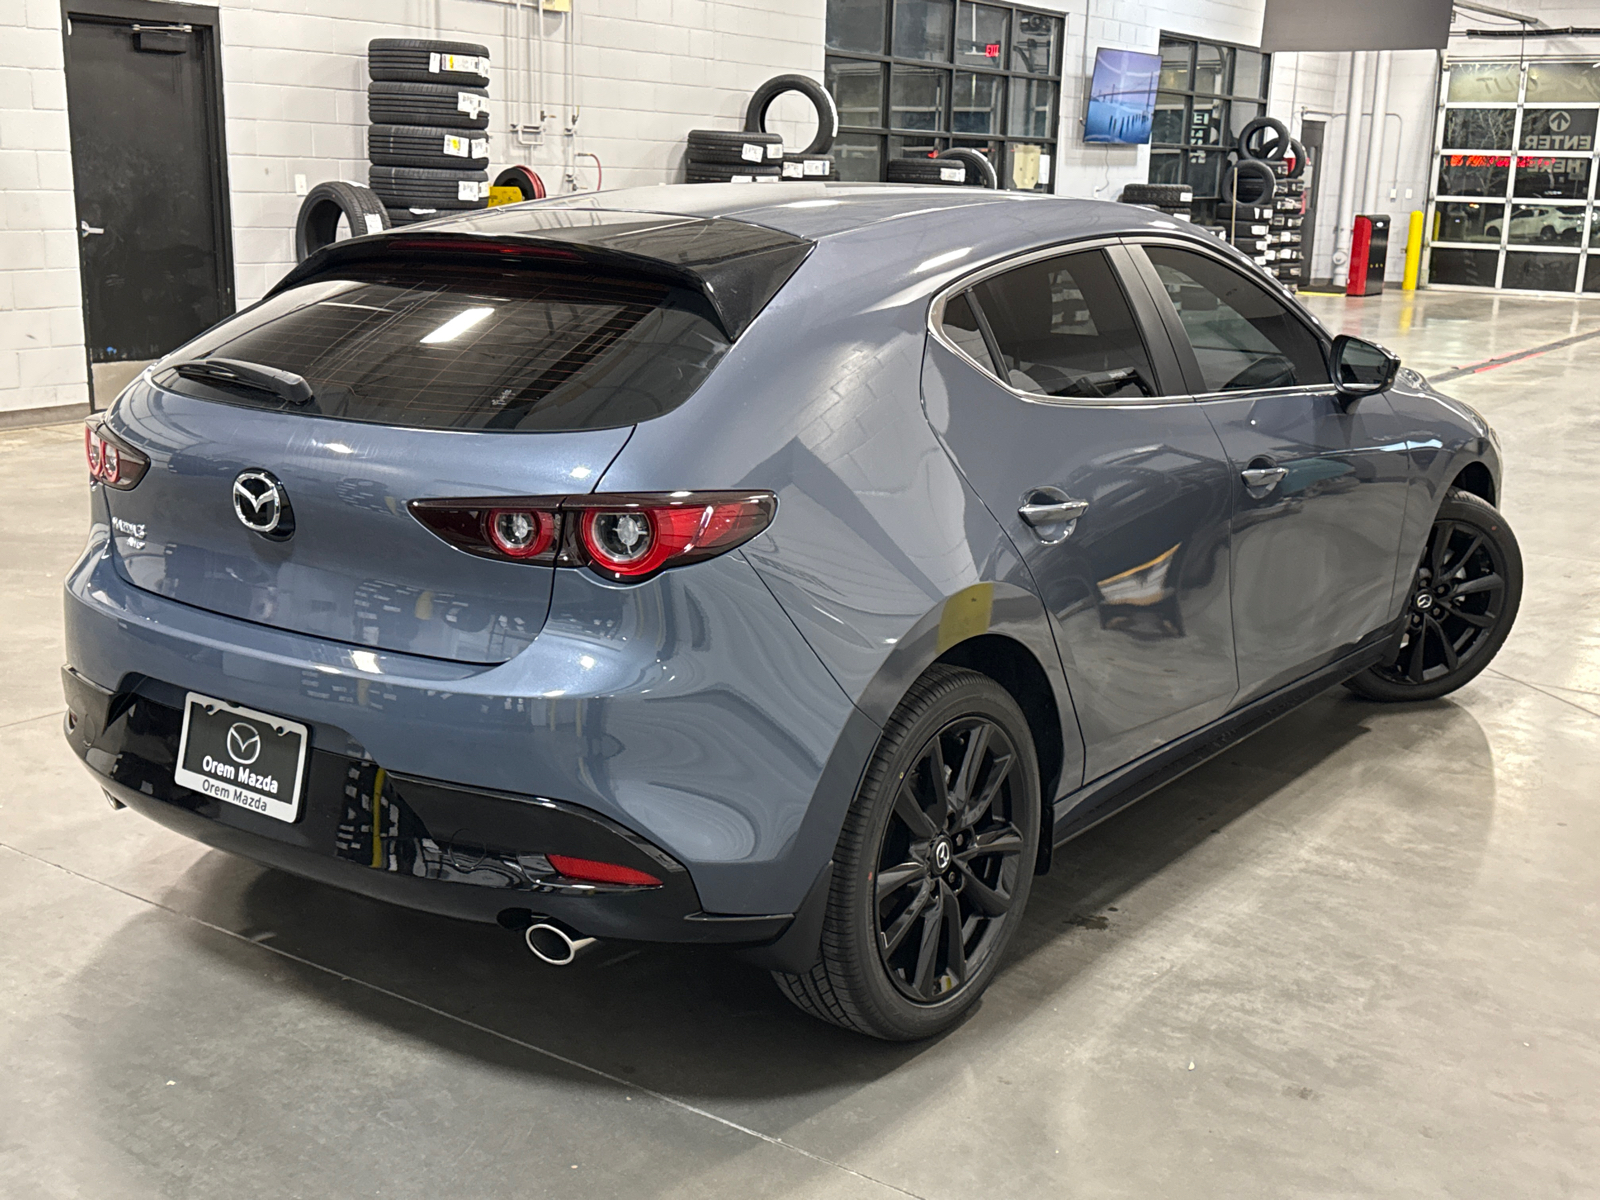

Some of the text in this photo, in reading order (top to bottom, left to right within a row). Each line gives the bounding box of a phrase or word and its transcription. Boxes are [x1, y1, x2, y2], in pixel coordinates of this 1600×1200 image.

[202, 755, 279, 794] Orem Mazda
[202, 779, 268, 812] Orem Mazda
